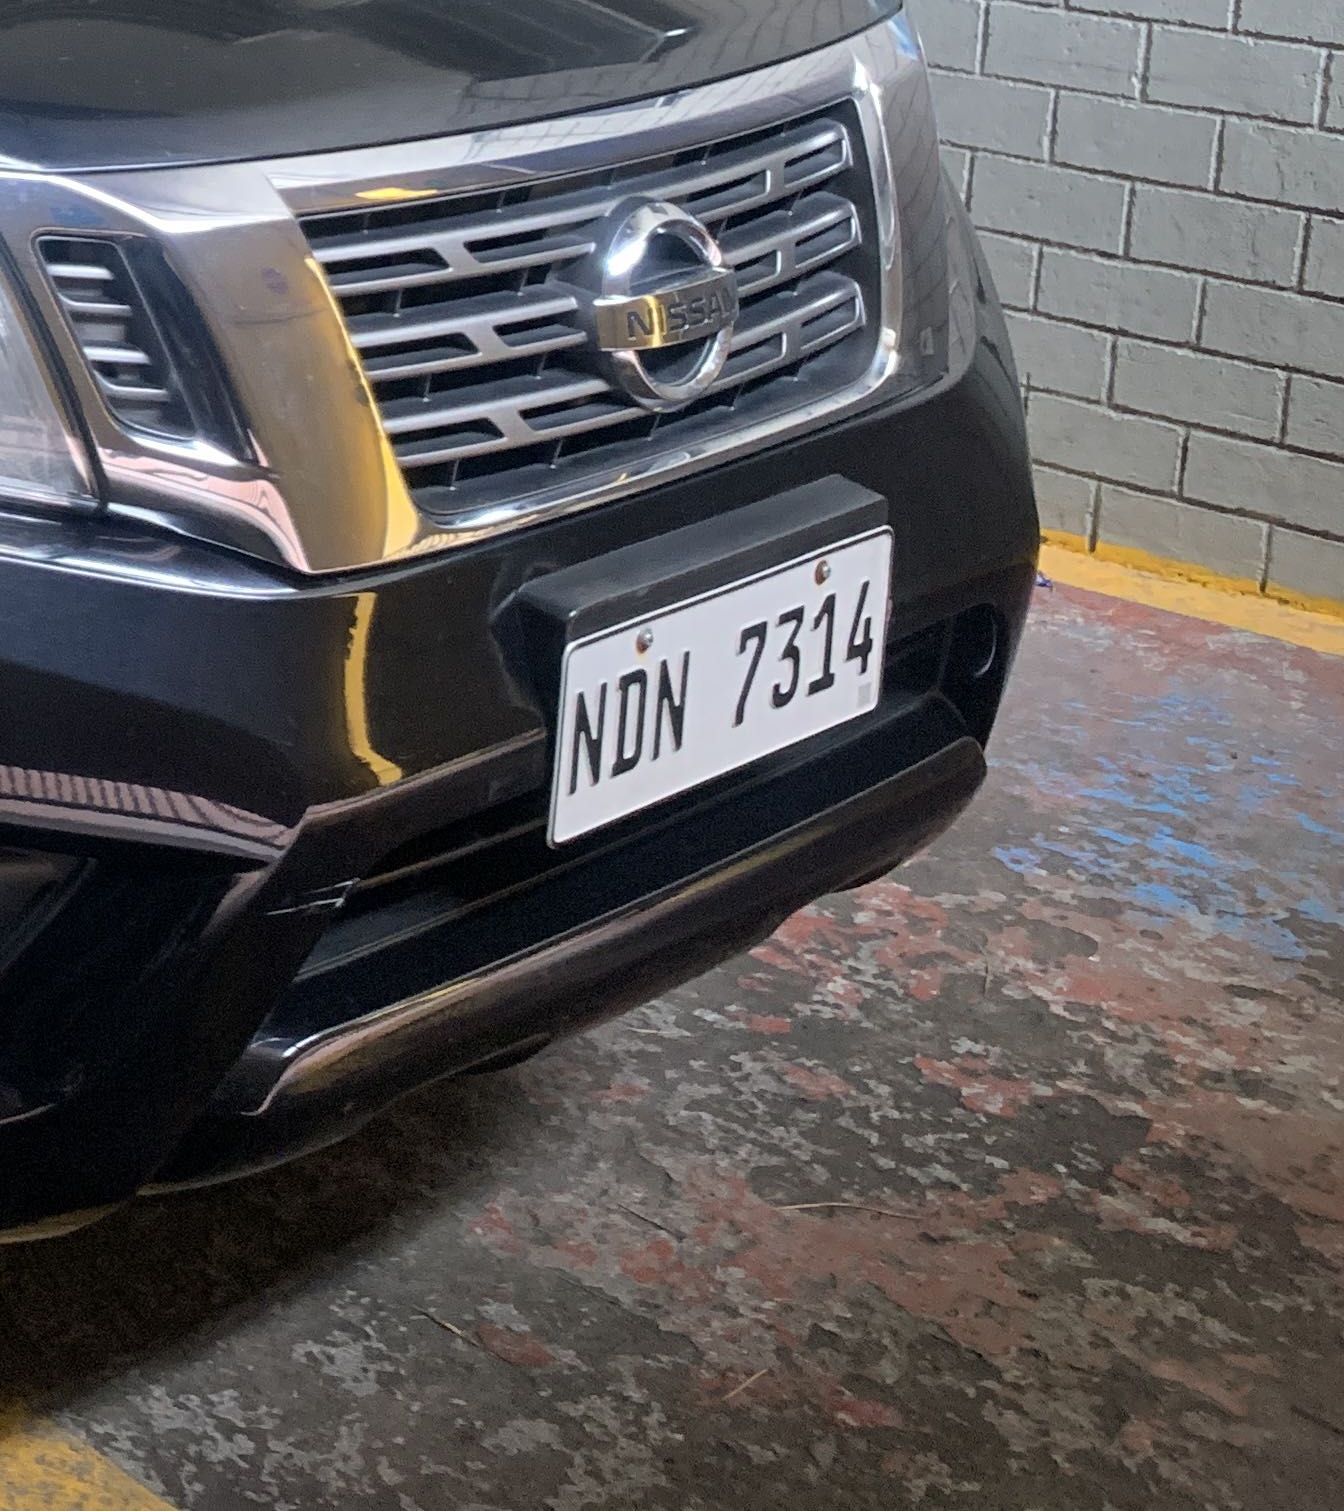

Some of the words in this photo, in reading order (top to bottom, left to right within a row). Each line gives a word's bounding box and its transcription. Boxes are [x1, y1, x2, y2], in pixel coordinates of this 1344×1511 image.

[626, 288, 733, 338] NISSAN
[568, 650, 691, 796] NDN
[731, 580, 874, 729] 7314
